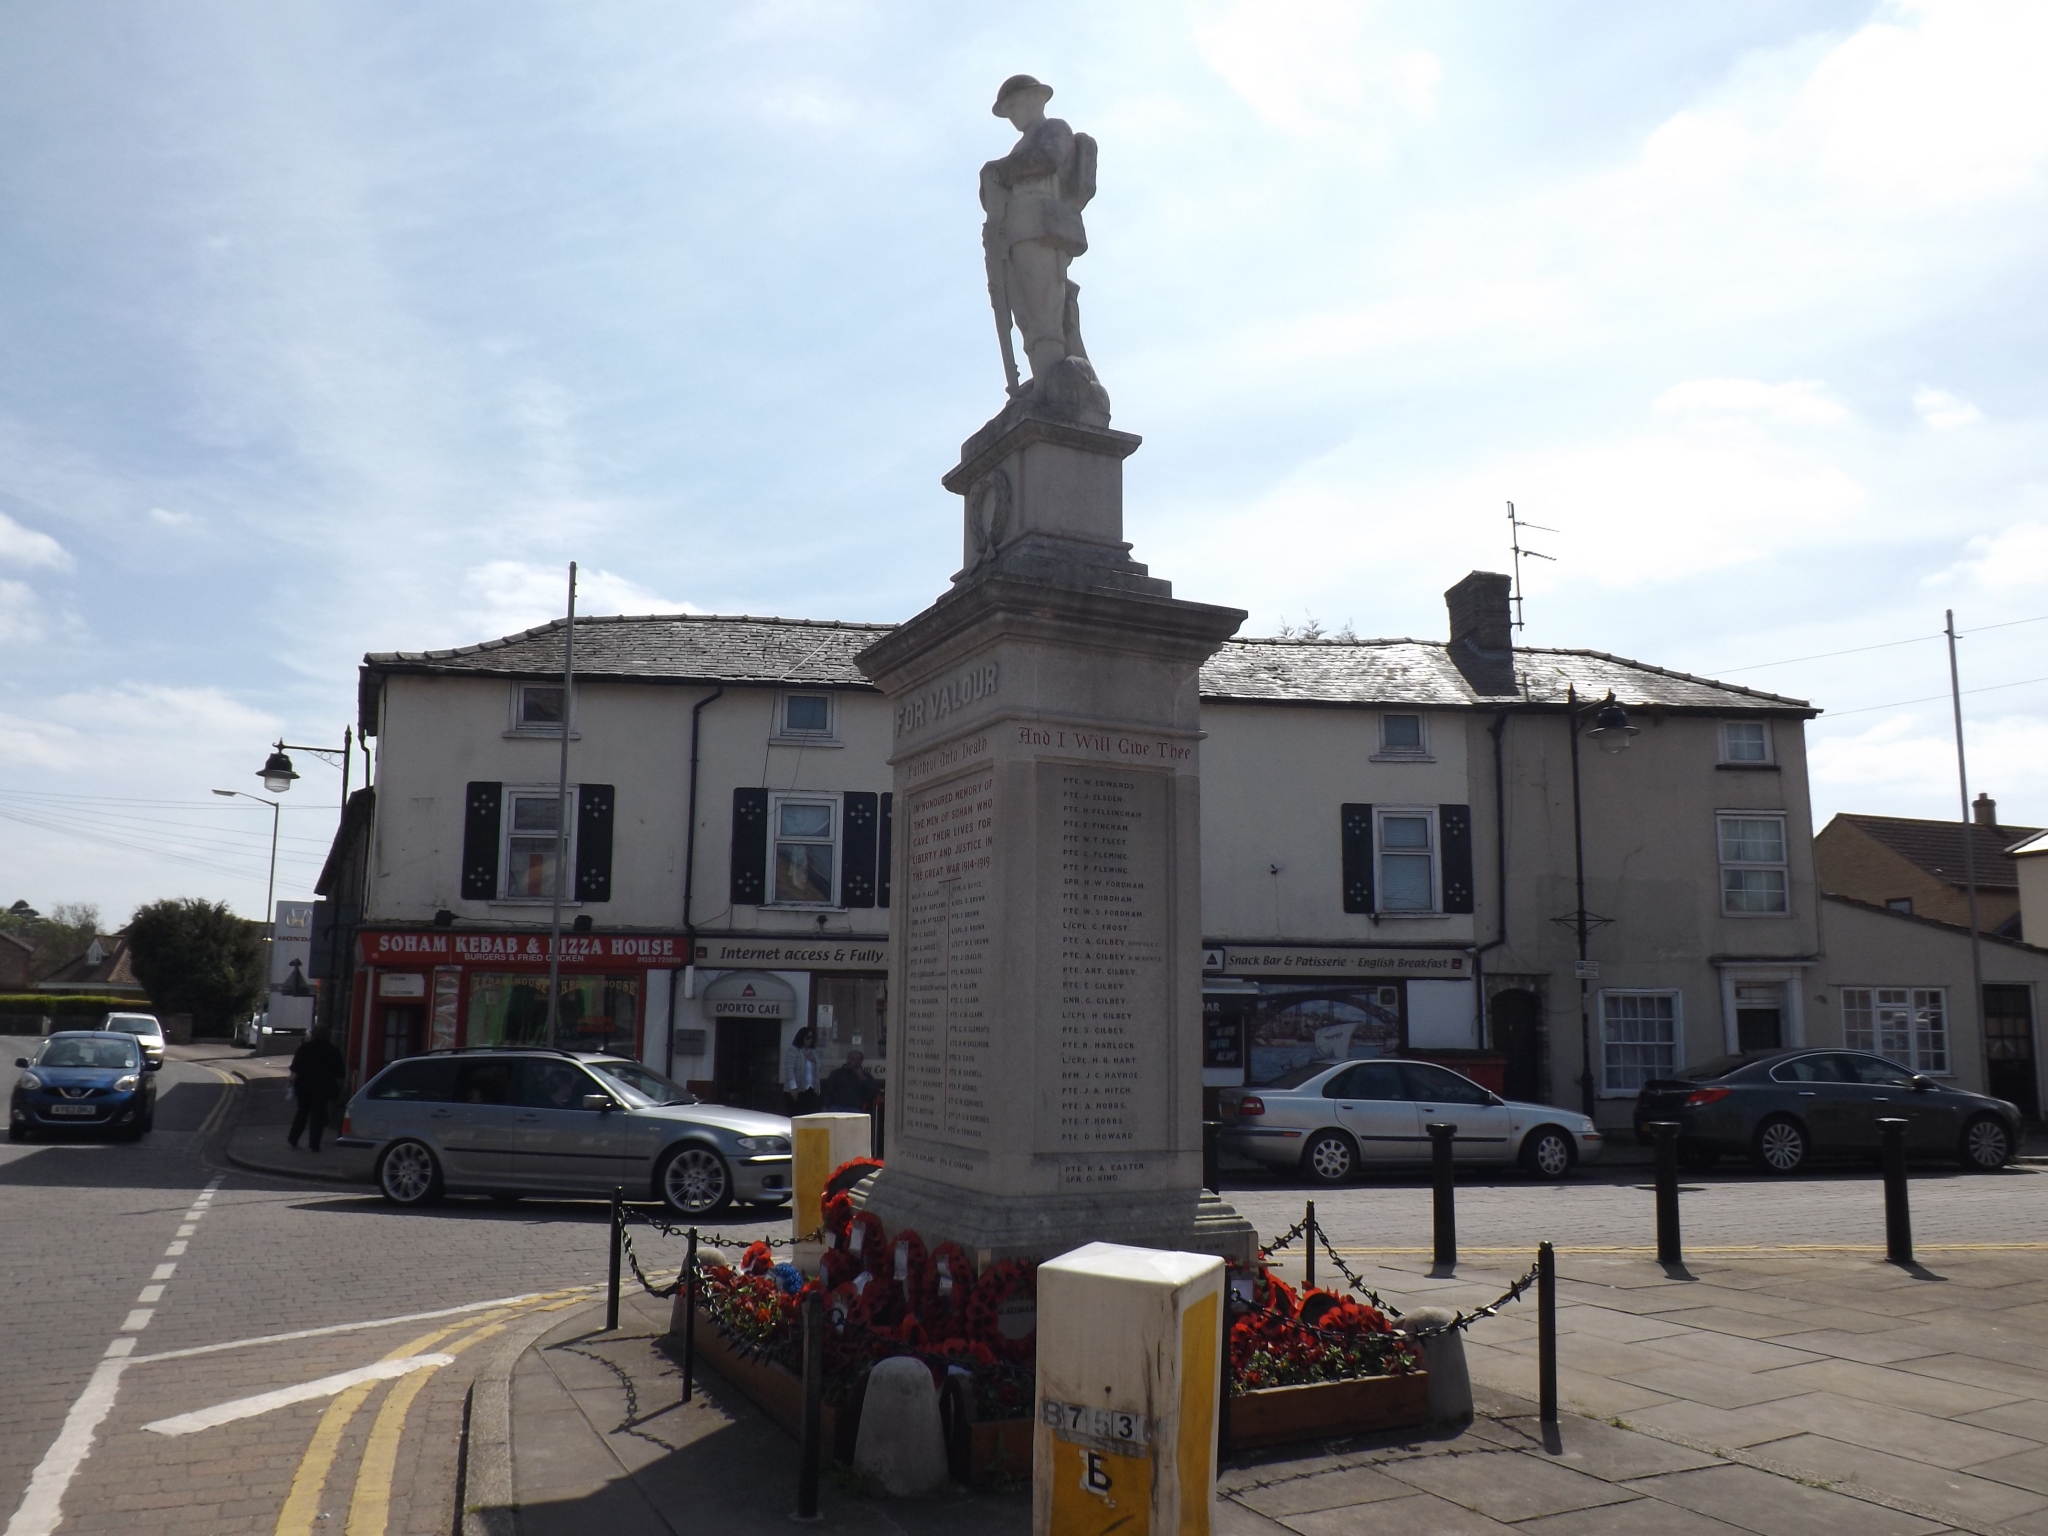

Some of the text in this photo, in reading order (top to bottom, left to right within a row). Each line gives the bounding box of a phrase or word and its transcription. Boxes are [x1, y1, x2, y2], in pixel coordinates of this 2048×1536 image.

[897, 661, 999, 737] FOR VALOUR
[1018, 727, 1191, 759] And I Will Give Thee
[921, 791, 952, 811] HONOURED
[955, 782, 982, 802] MEMORY
[984, 779, 992, 791] OF
[914, 798, 992, 830] THE MEN OF SOHAM WHO
[913, 818, 991, 847] GAVE THEIR LIVES FOR
[913, 836, 992, 864] LIBERTY AND JUSTICE IN
[913, 867, 922, 881] THE
[924, 862, 943, 879] GREAT
[946, 858, 960, 873] WAR
[379, 935, 447, 952] SOHAM
[455, 936, 518, 953] KEBAB
[526, 938, 540, 954] &
[611, 939, 674, 955] HOUSE
[517, 953, 543, 961] FRIED
[720, 946, 884, 964] Internet access & Fully
[1228, 955, 1448, 970] Snack Bar & Patisserie English Breakfast
[716, 1002, 780, 1014] OPORTO CAFÉ
